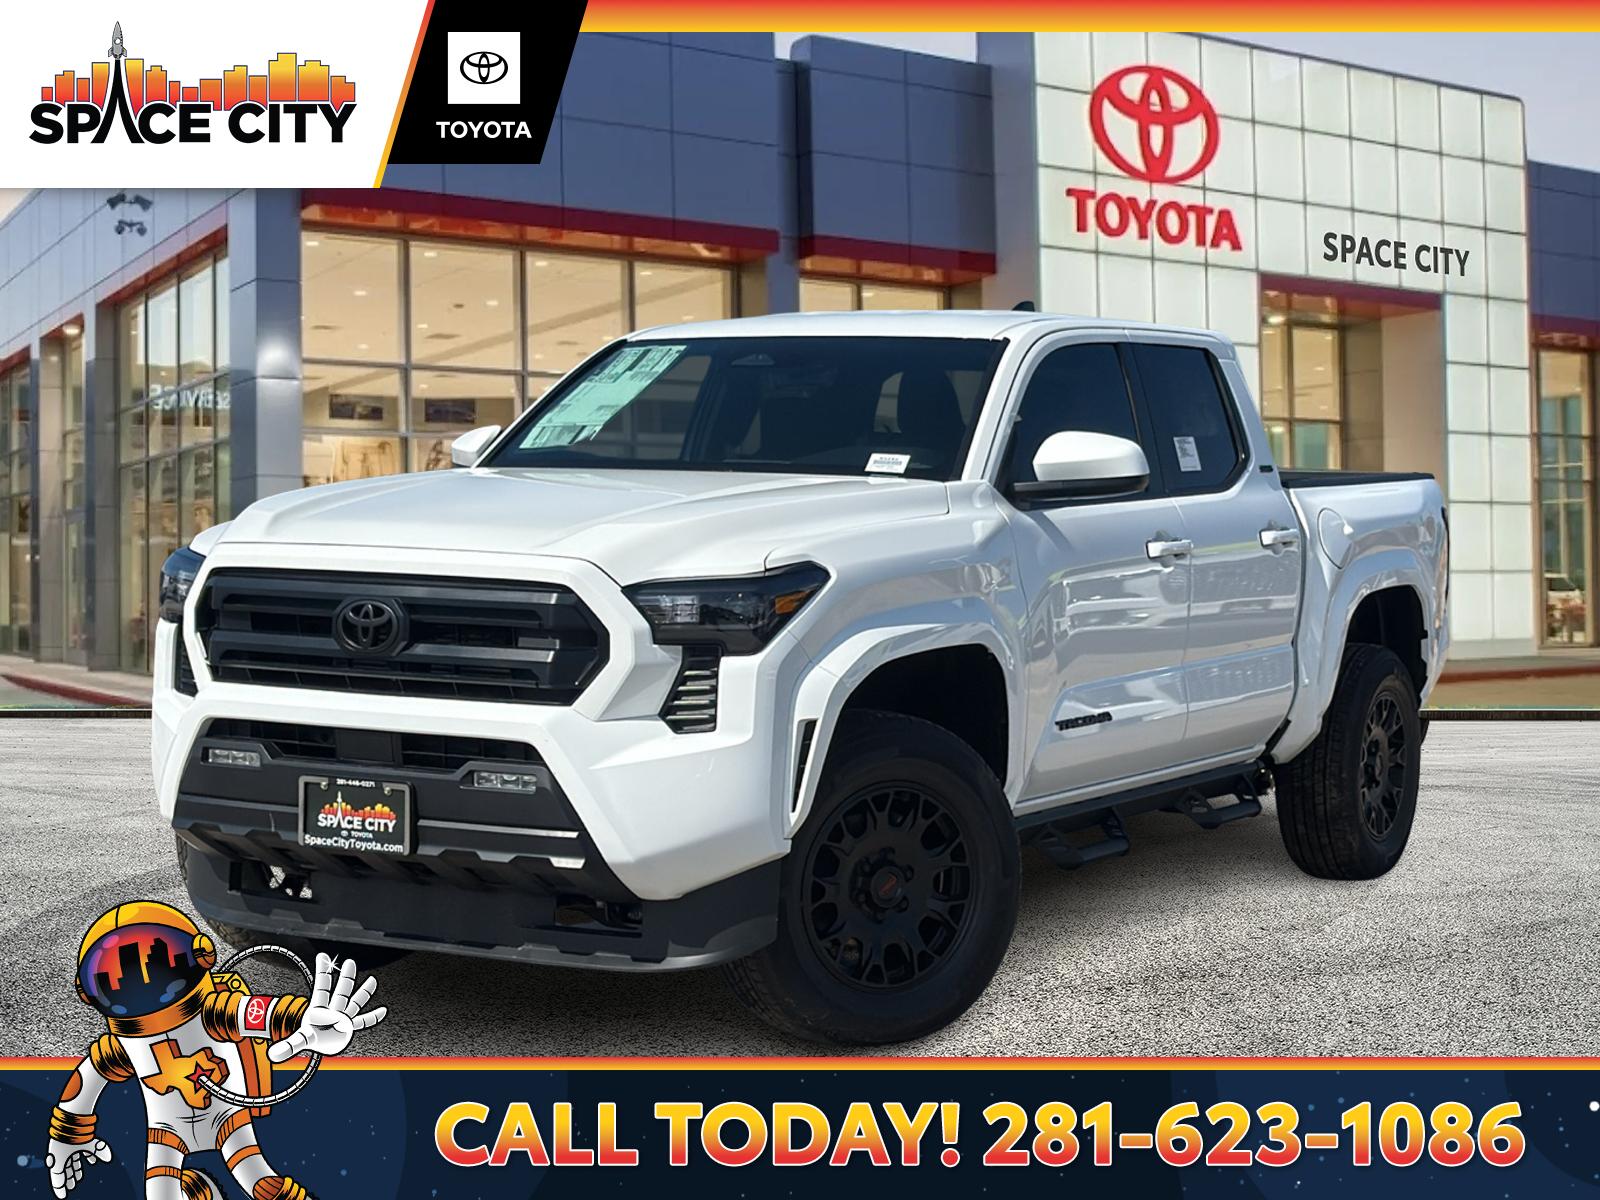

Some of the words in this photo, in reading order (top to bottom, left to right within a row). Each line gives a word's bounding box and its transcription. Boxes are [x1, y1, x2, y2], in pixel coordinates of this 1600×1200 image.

[1066, 188, 1242, 251] TOYOTA
[1323, 231, 1407, 270] SPACE
[1415, 244, 1470, 277] CITY
[317, 804, 362, 829] SPACE
[365, 817, 396, 832] CITY
[304, 834, 403, 853] SpaceCityToyota.com
[350, 831, 374, 839] TOYOTA
